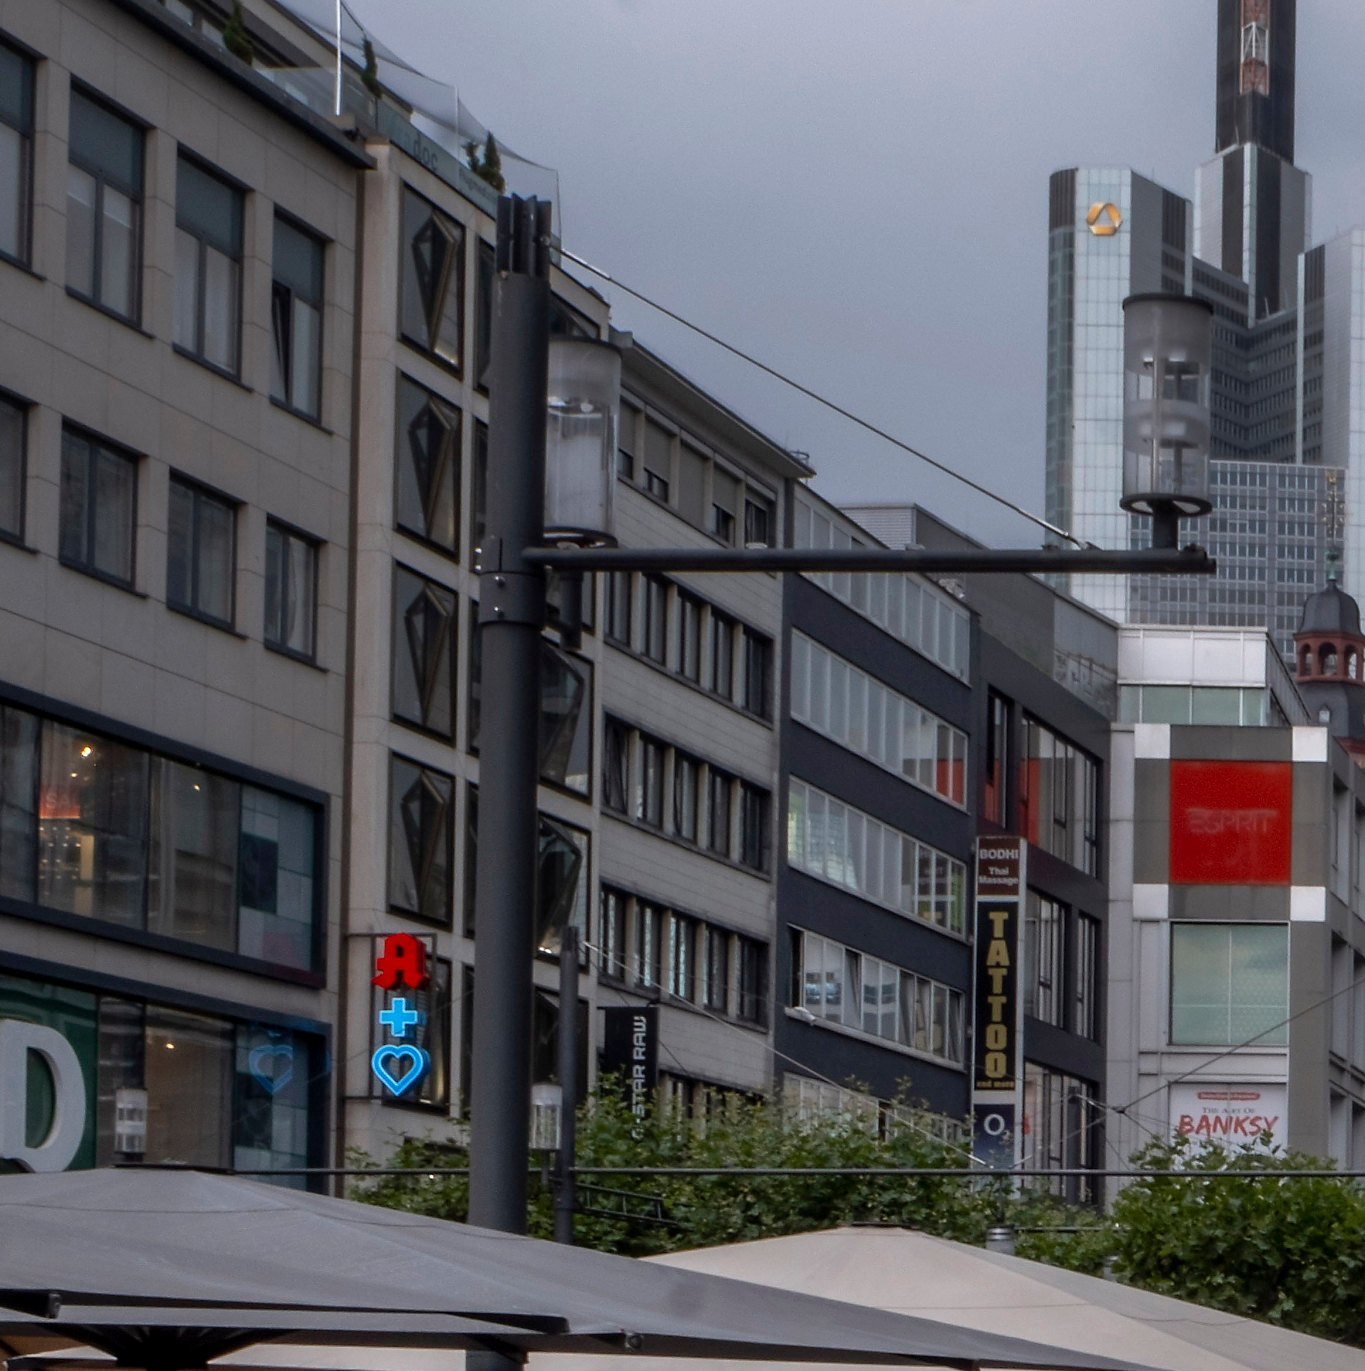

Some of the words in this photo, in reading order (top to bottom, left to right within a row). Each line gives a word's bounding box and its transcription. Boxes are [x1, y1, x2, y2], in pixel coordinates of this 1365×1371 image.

[1185, 807, 1278, 834] ESPRIT
[979, 848, 1019, 860] BODHI
[988, 866, 1009, 876] Thai
[985, 911, 1010, 1079] TATTOO
[632, 1015, 647, 1061] RAW
[1179, 1114, 1279, 1138] BANKSY
